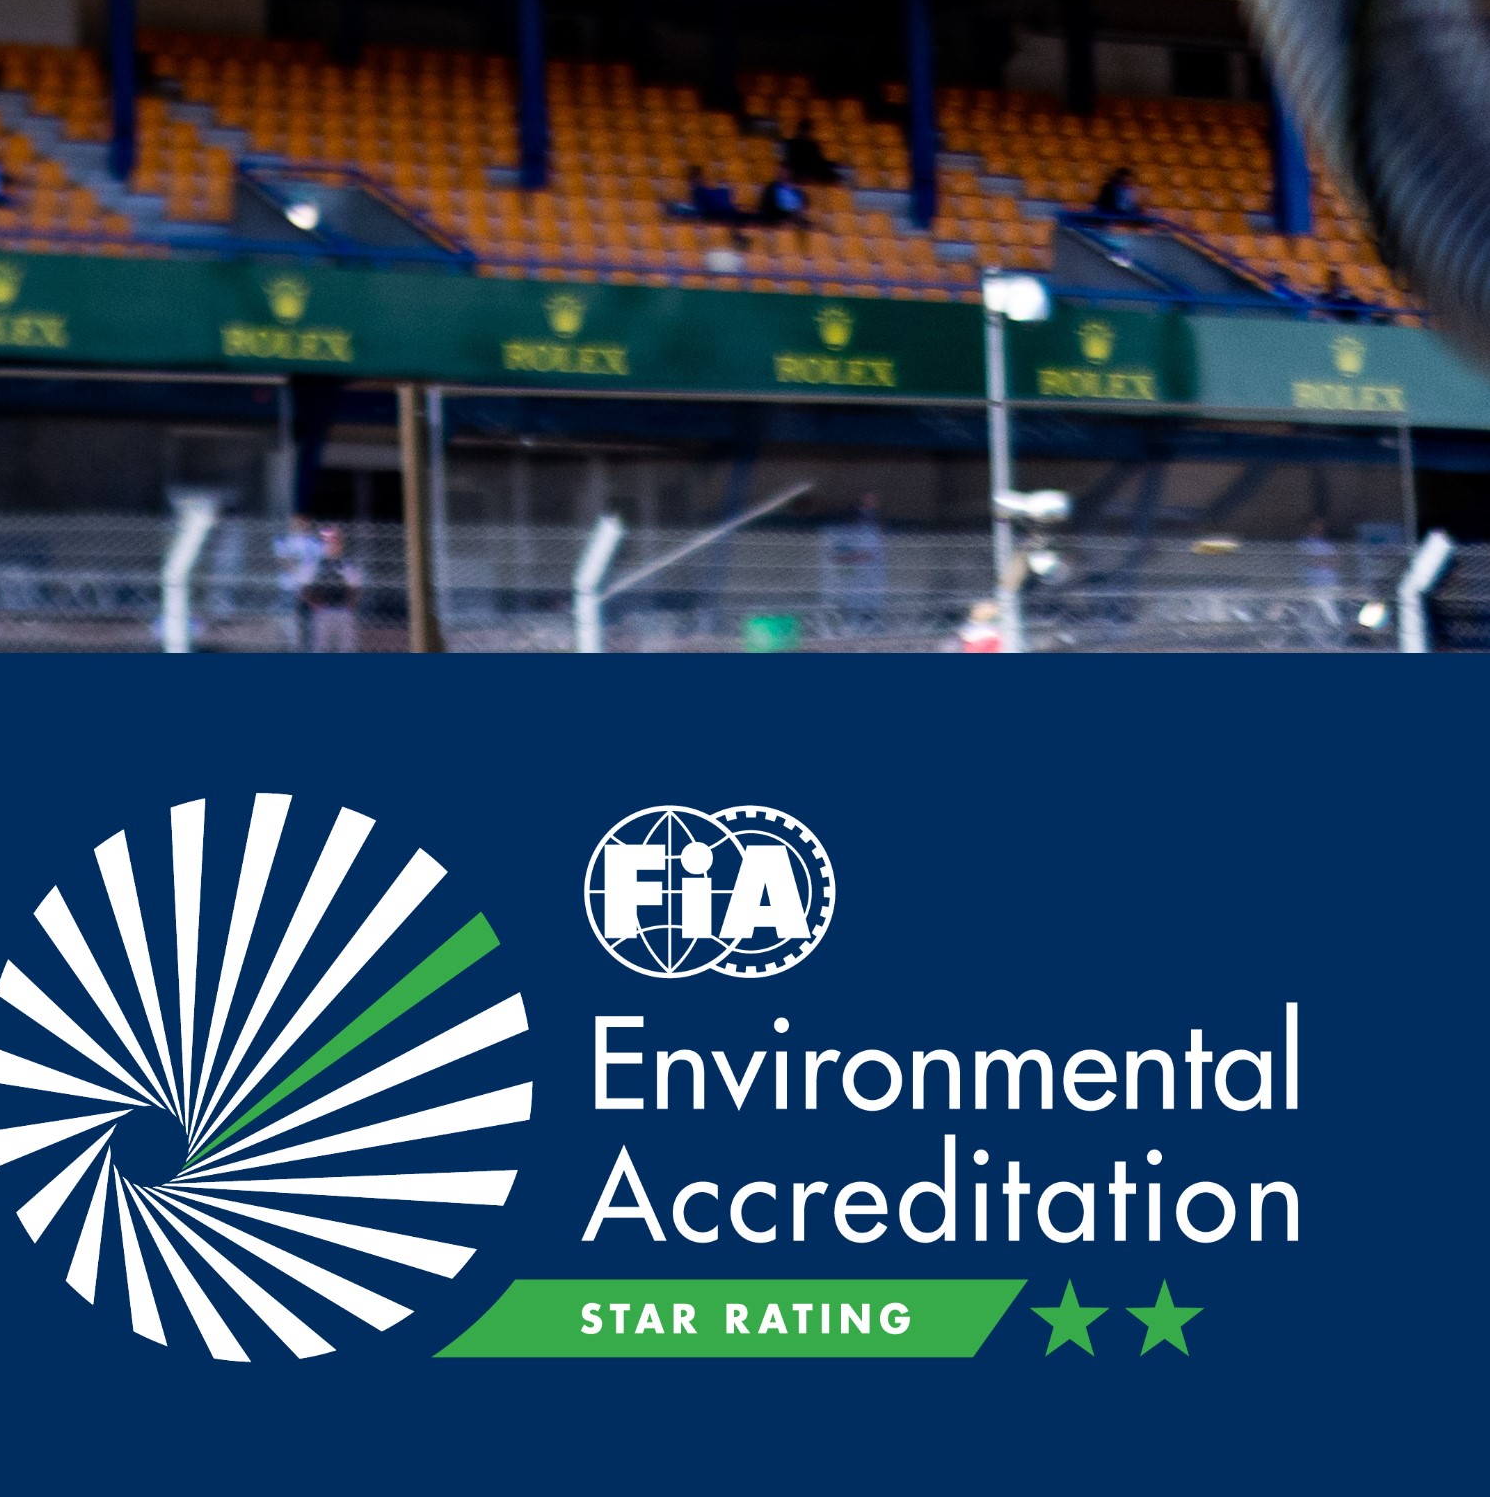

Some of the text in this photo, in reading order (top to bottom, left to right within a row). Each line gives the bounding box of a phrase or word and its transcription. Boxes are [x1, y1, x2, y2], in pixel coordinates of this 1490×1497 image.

[501, 340, 630, 376] ROLEX
[773, 354, 897, 388] ROLEX
[1036, 367, 1157, 401] ROLEX
[1292, 381, 1406, 412] ROLEX
